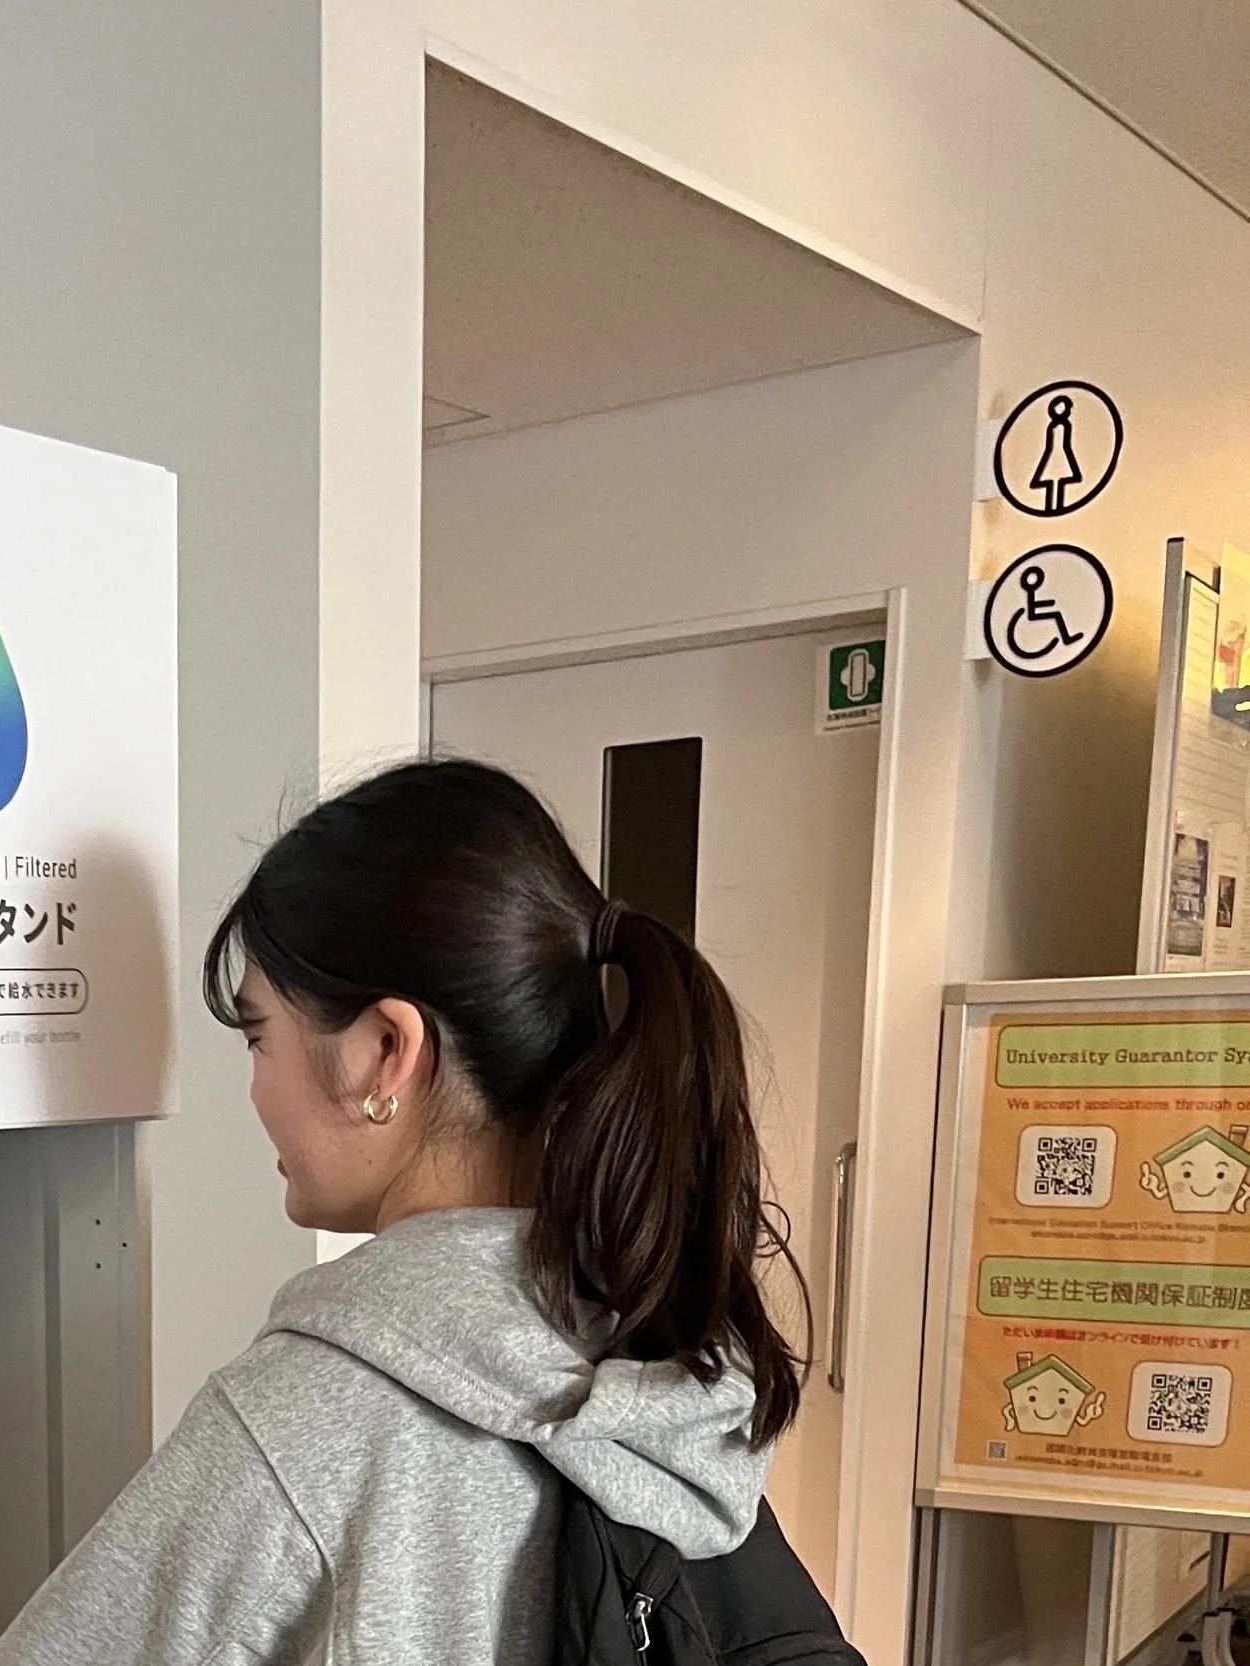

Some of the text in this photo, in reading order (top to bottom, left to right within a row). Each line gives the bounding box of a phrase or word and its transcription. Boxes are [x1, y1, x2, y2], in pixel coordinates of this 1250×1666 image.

[15, 856, 77, 879] Filtered
[1006, 1047, 1250, 1065] University Guarantor Sy
[1007, 1098, 1029, 1110] We
